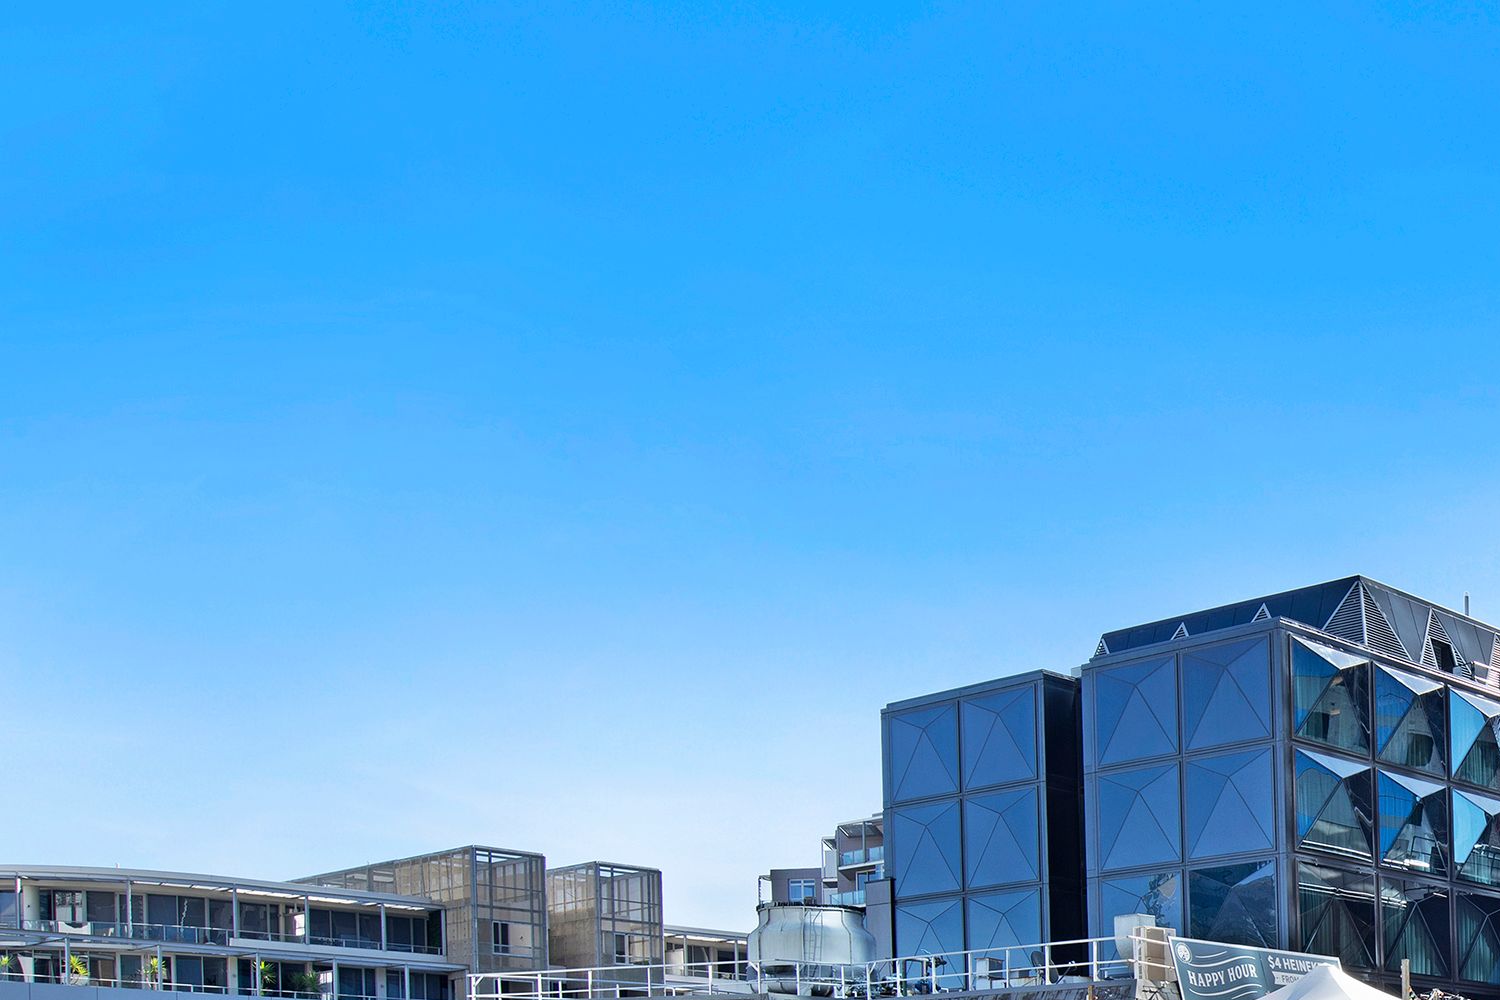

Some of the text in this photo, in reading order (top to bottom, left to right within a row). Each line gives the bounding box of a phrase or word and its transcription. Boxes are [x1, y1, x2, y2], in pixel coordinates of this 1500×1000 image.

[1267, 955, 1282, 970] $4
[1187, 963, 1258, 988] HAPPY HOUR
